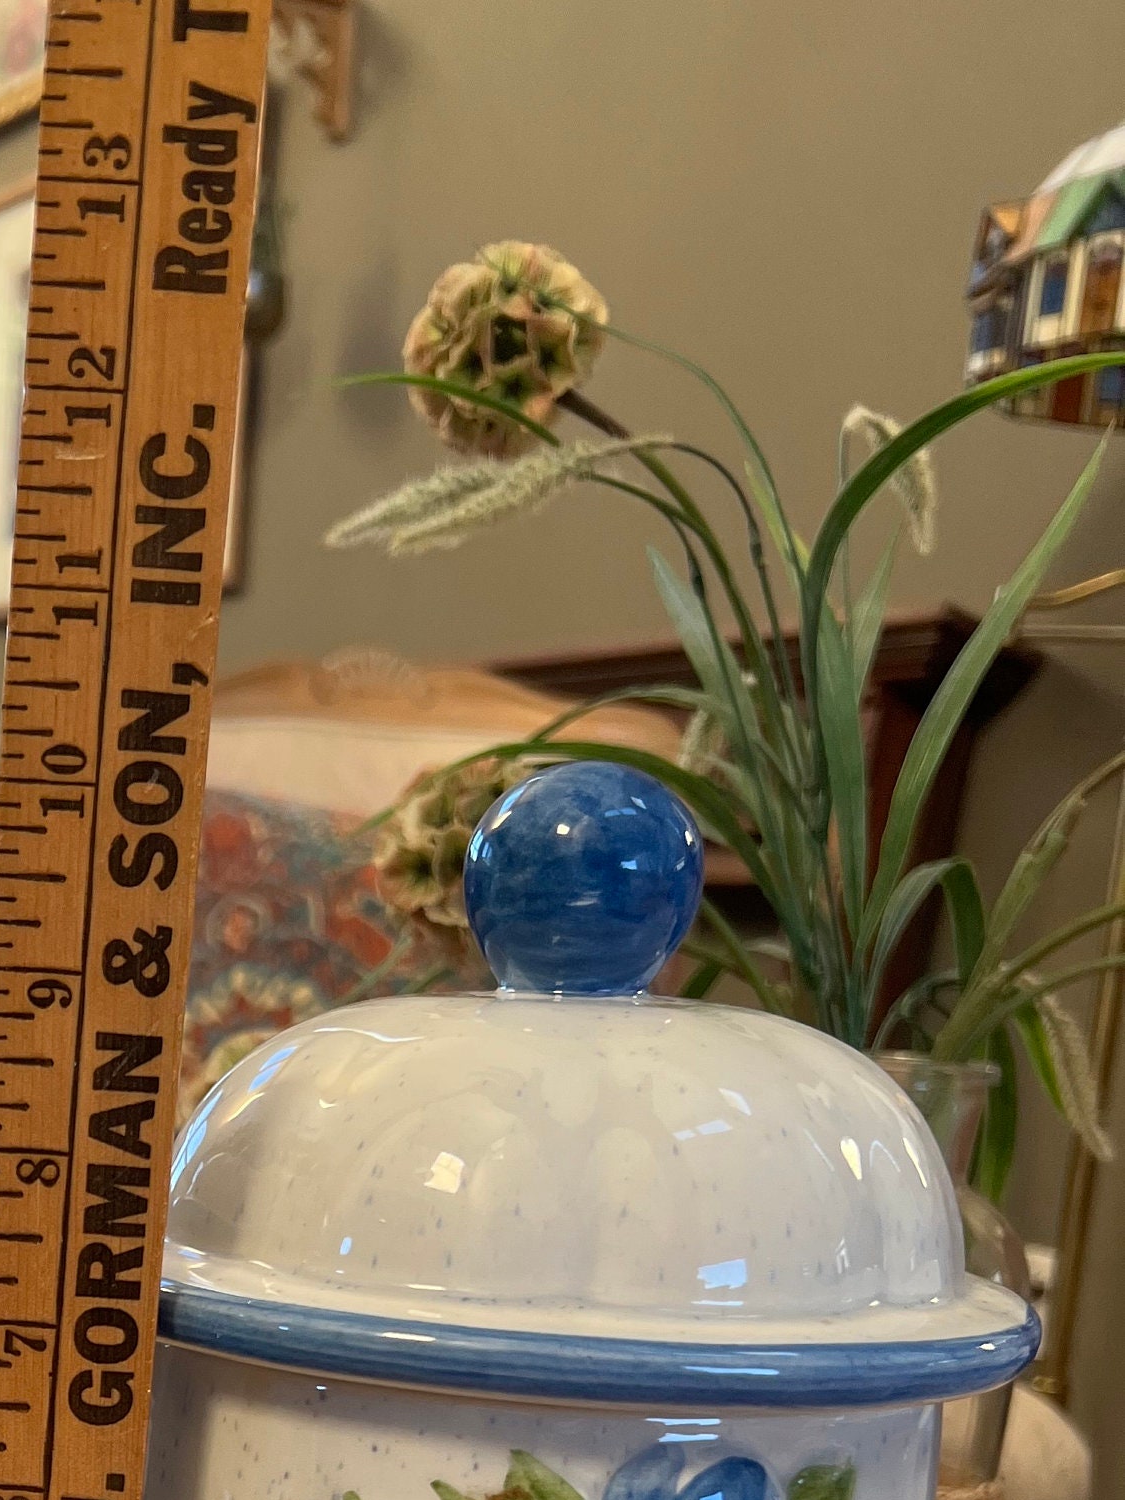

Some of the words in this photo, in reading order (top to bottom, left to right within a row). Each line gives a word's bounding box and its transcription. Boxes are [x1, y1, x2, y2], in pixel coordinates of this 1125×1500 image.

[77, 133, 132, 223] 13
[152, 80, 257, 294] Ready
[64, 345, 117, 428] 12
[130, 403, 216, 606] INC.
[51, 547, 103, 626] 11
[38, 743, 88, 819] 10
[108, 662, 209, 891] SON,
[27, 978, 73, 1009] 9
[102, 925, 173, 998] &
[15, 1158, 61, 1187] 8
[68, 1031, 163, 1426] GORMAN
[3, 1328, 48, 1356] 7
